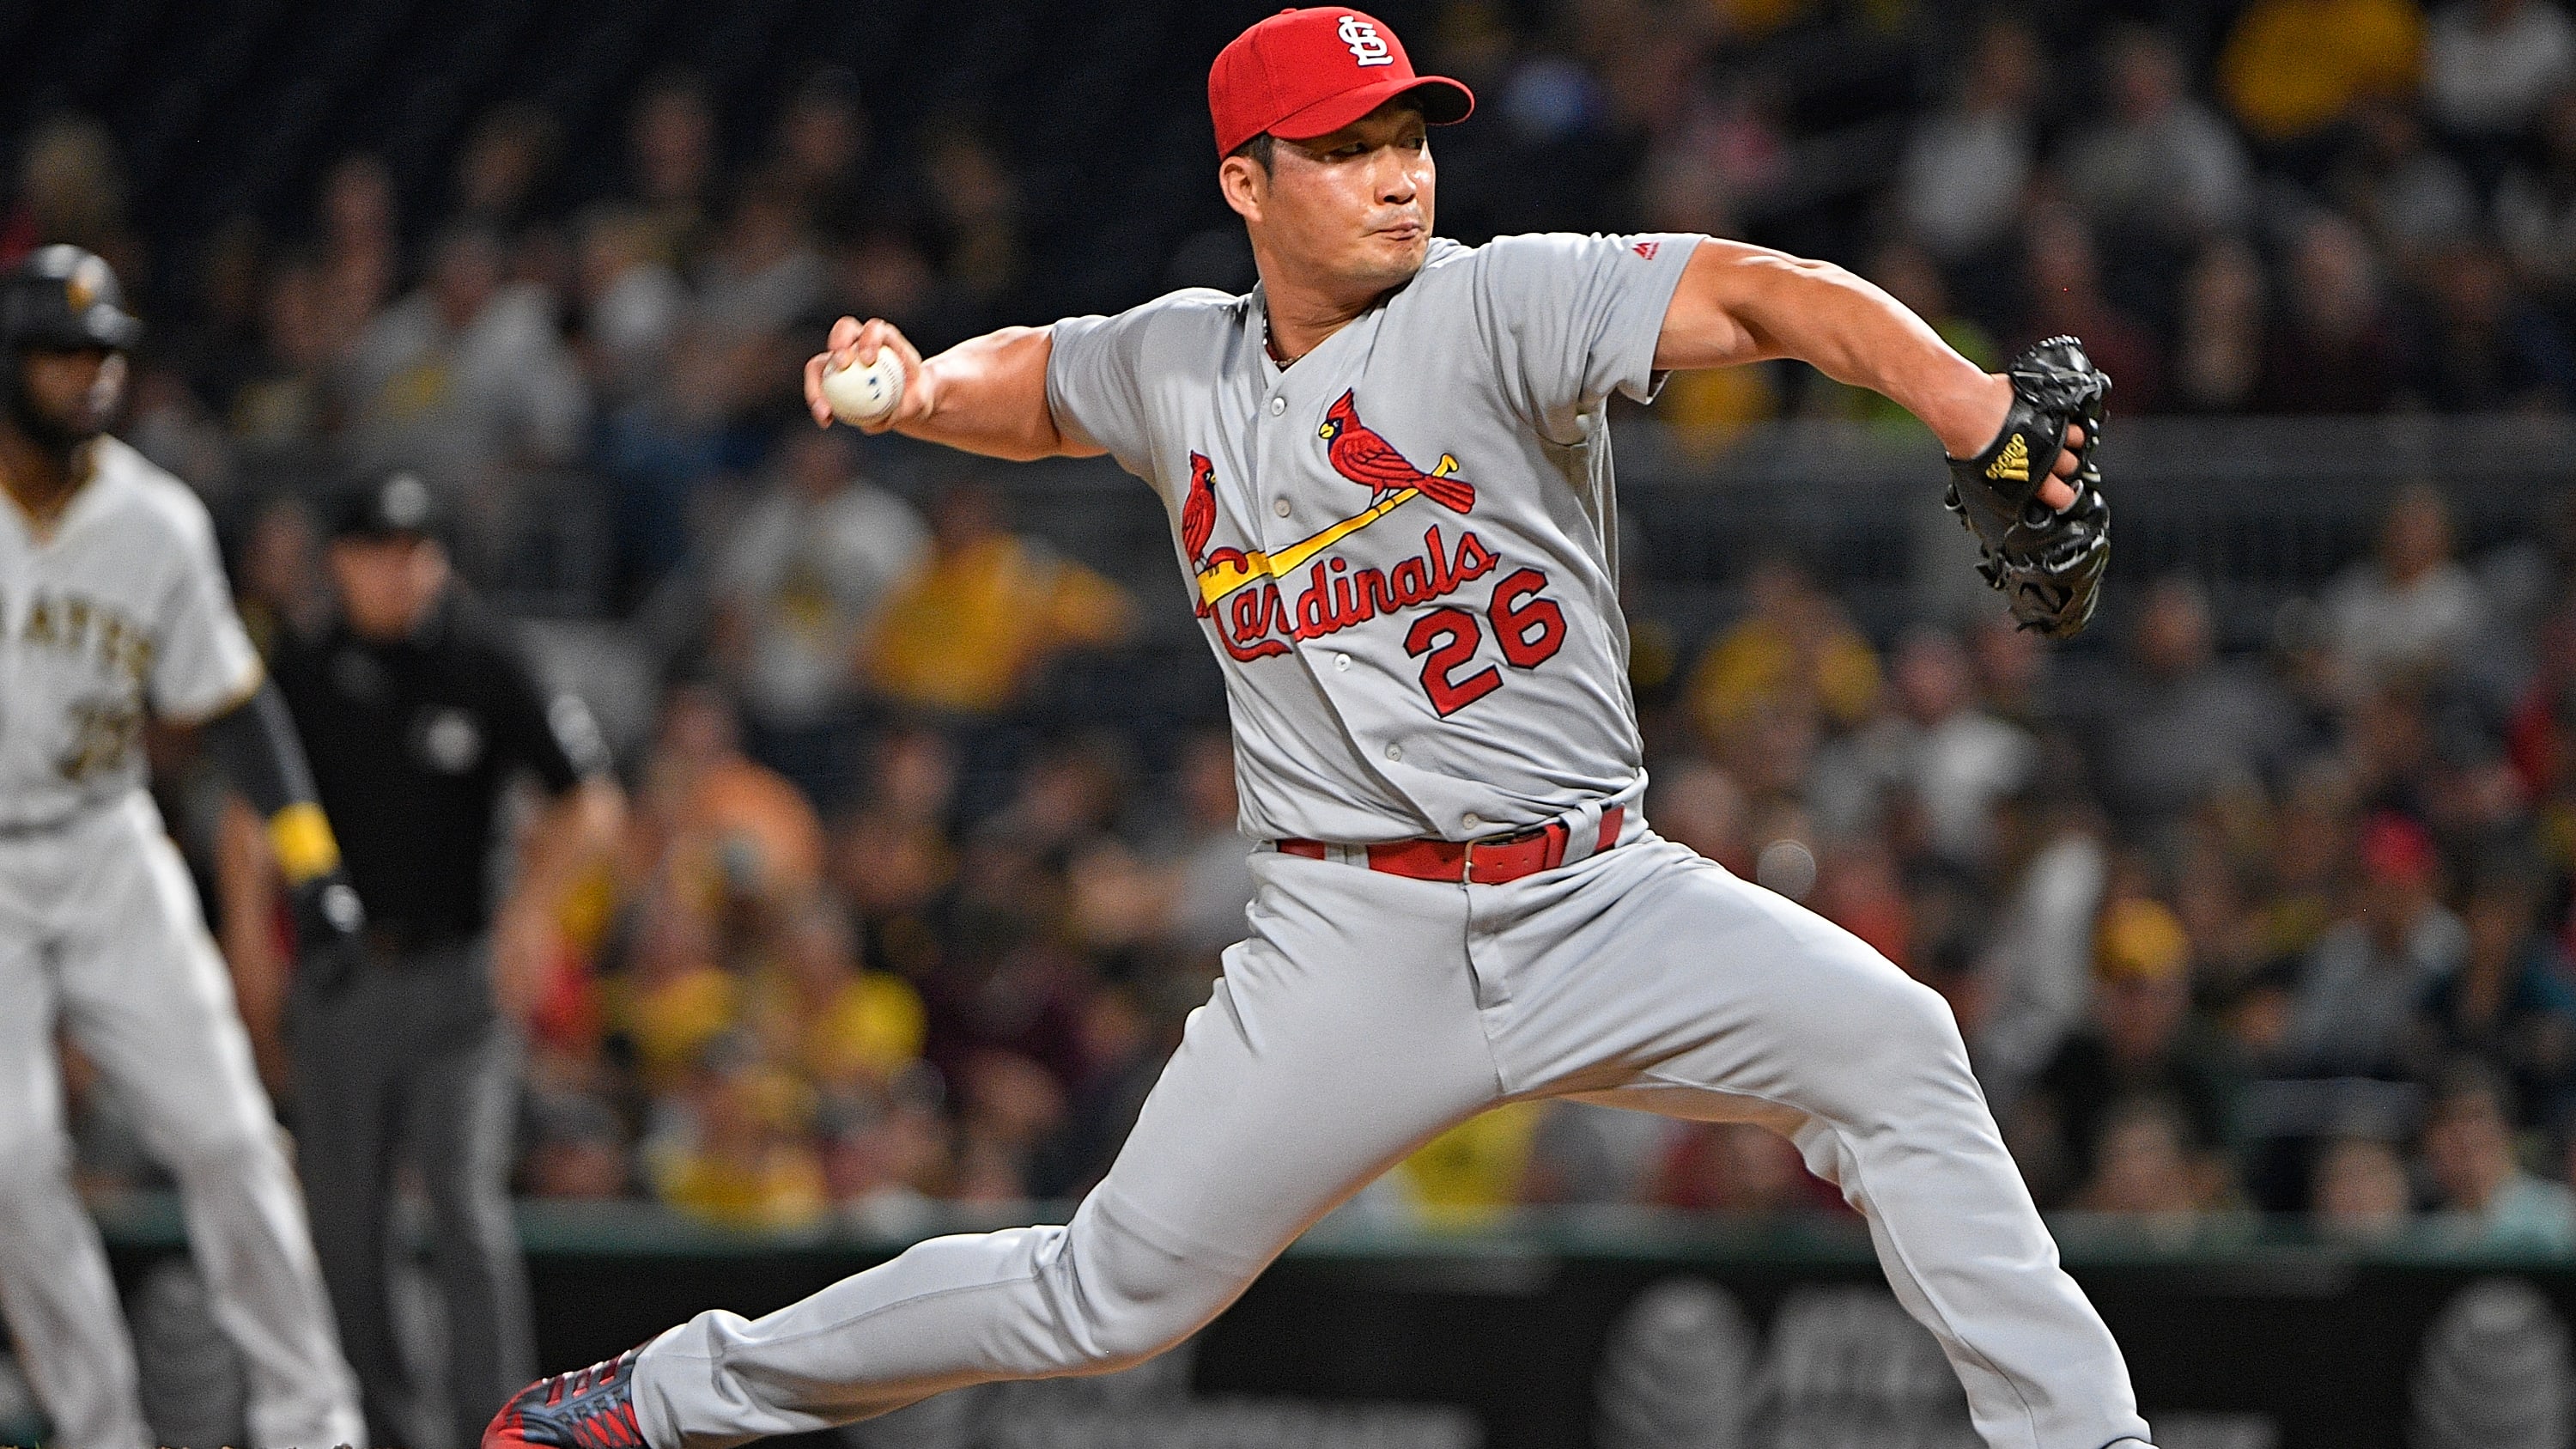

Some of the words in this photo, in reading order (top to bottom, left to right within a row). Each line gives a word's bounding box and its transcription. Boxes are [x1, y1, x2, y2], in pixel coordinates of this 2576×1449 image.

[1985, 433, 2023, 480] adidas
[1206, 524, 1501, 663] Cardinals
[1403, 568, 1567, 718] 26
